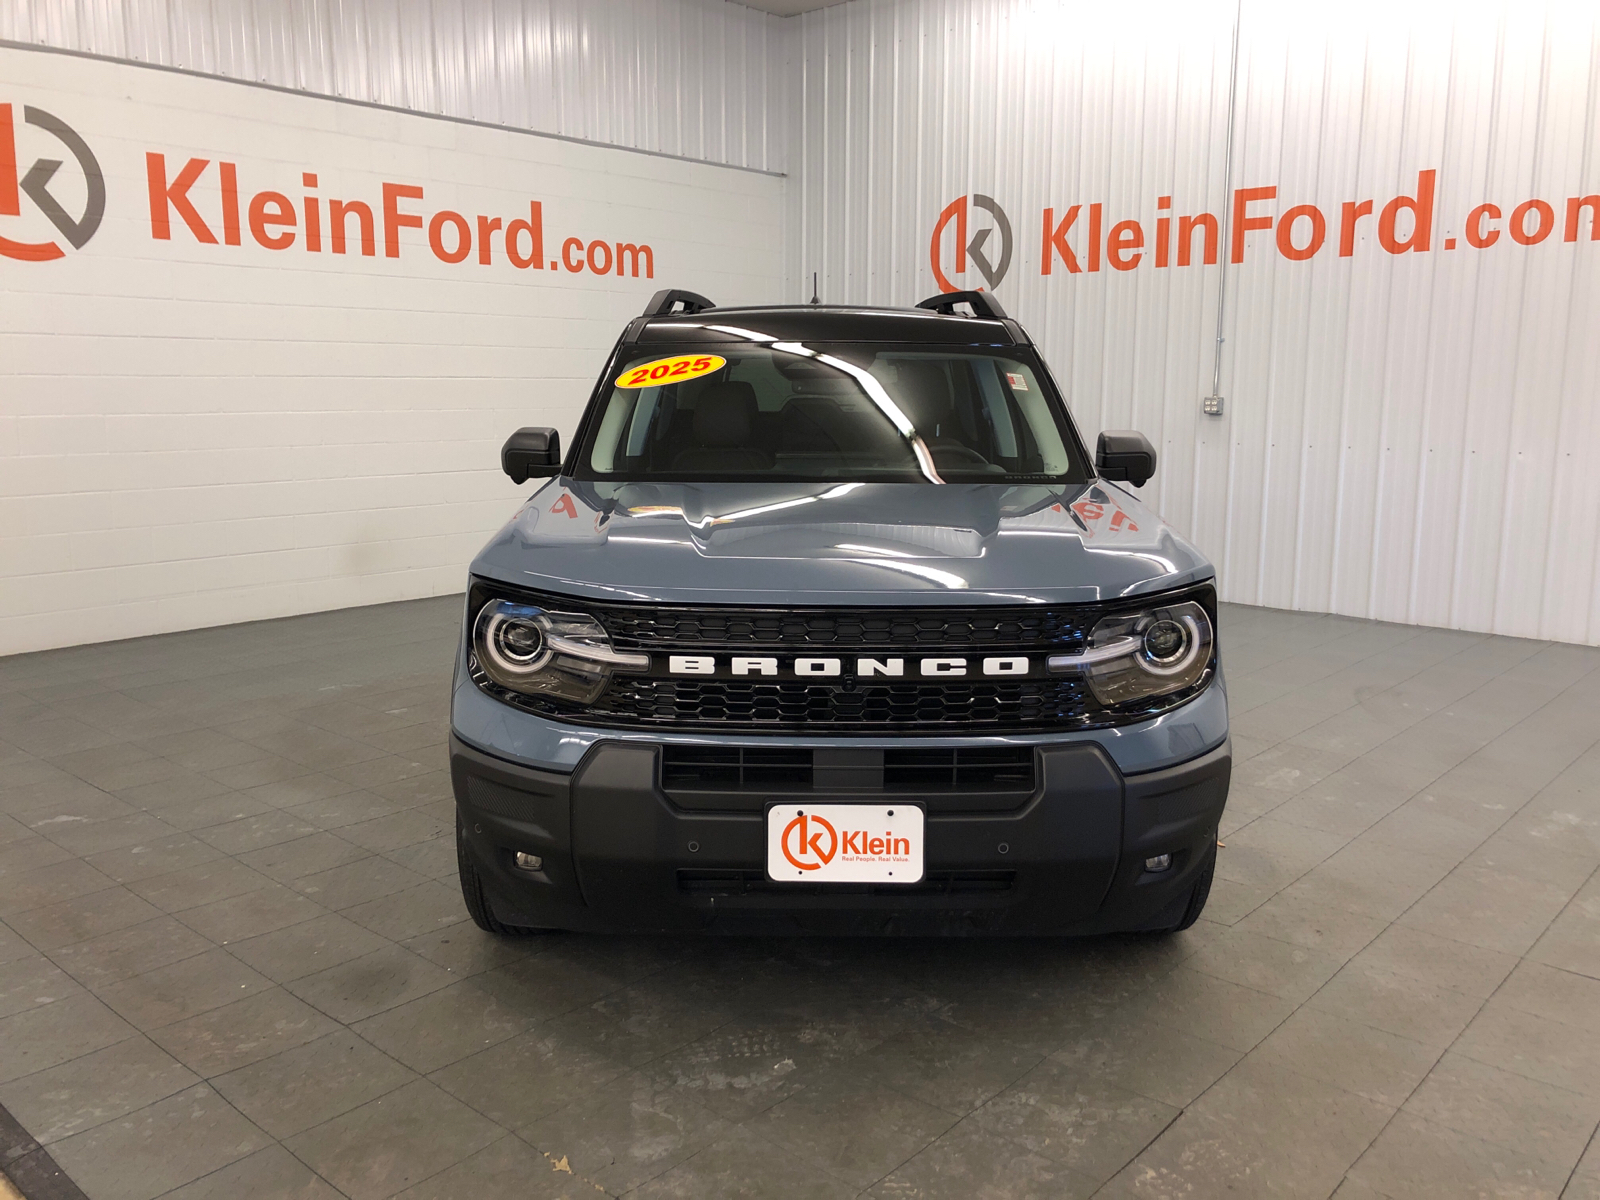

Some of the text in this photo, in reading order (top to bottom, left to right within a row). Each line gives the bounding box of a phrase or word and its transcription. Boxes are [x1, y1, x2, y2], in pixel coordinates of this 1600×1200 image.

[146, 152, 654, 278] KleinFord.com
[628, 357, 713, 386] 2025
[669, 655, 1029, 676] BRONCO
[842, 831, 910, 855] Klein
[855, 855, 877, 863] People.
